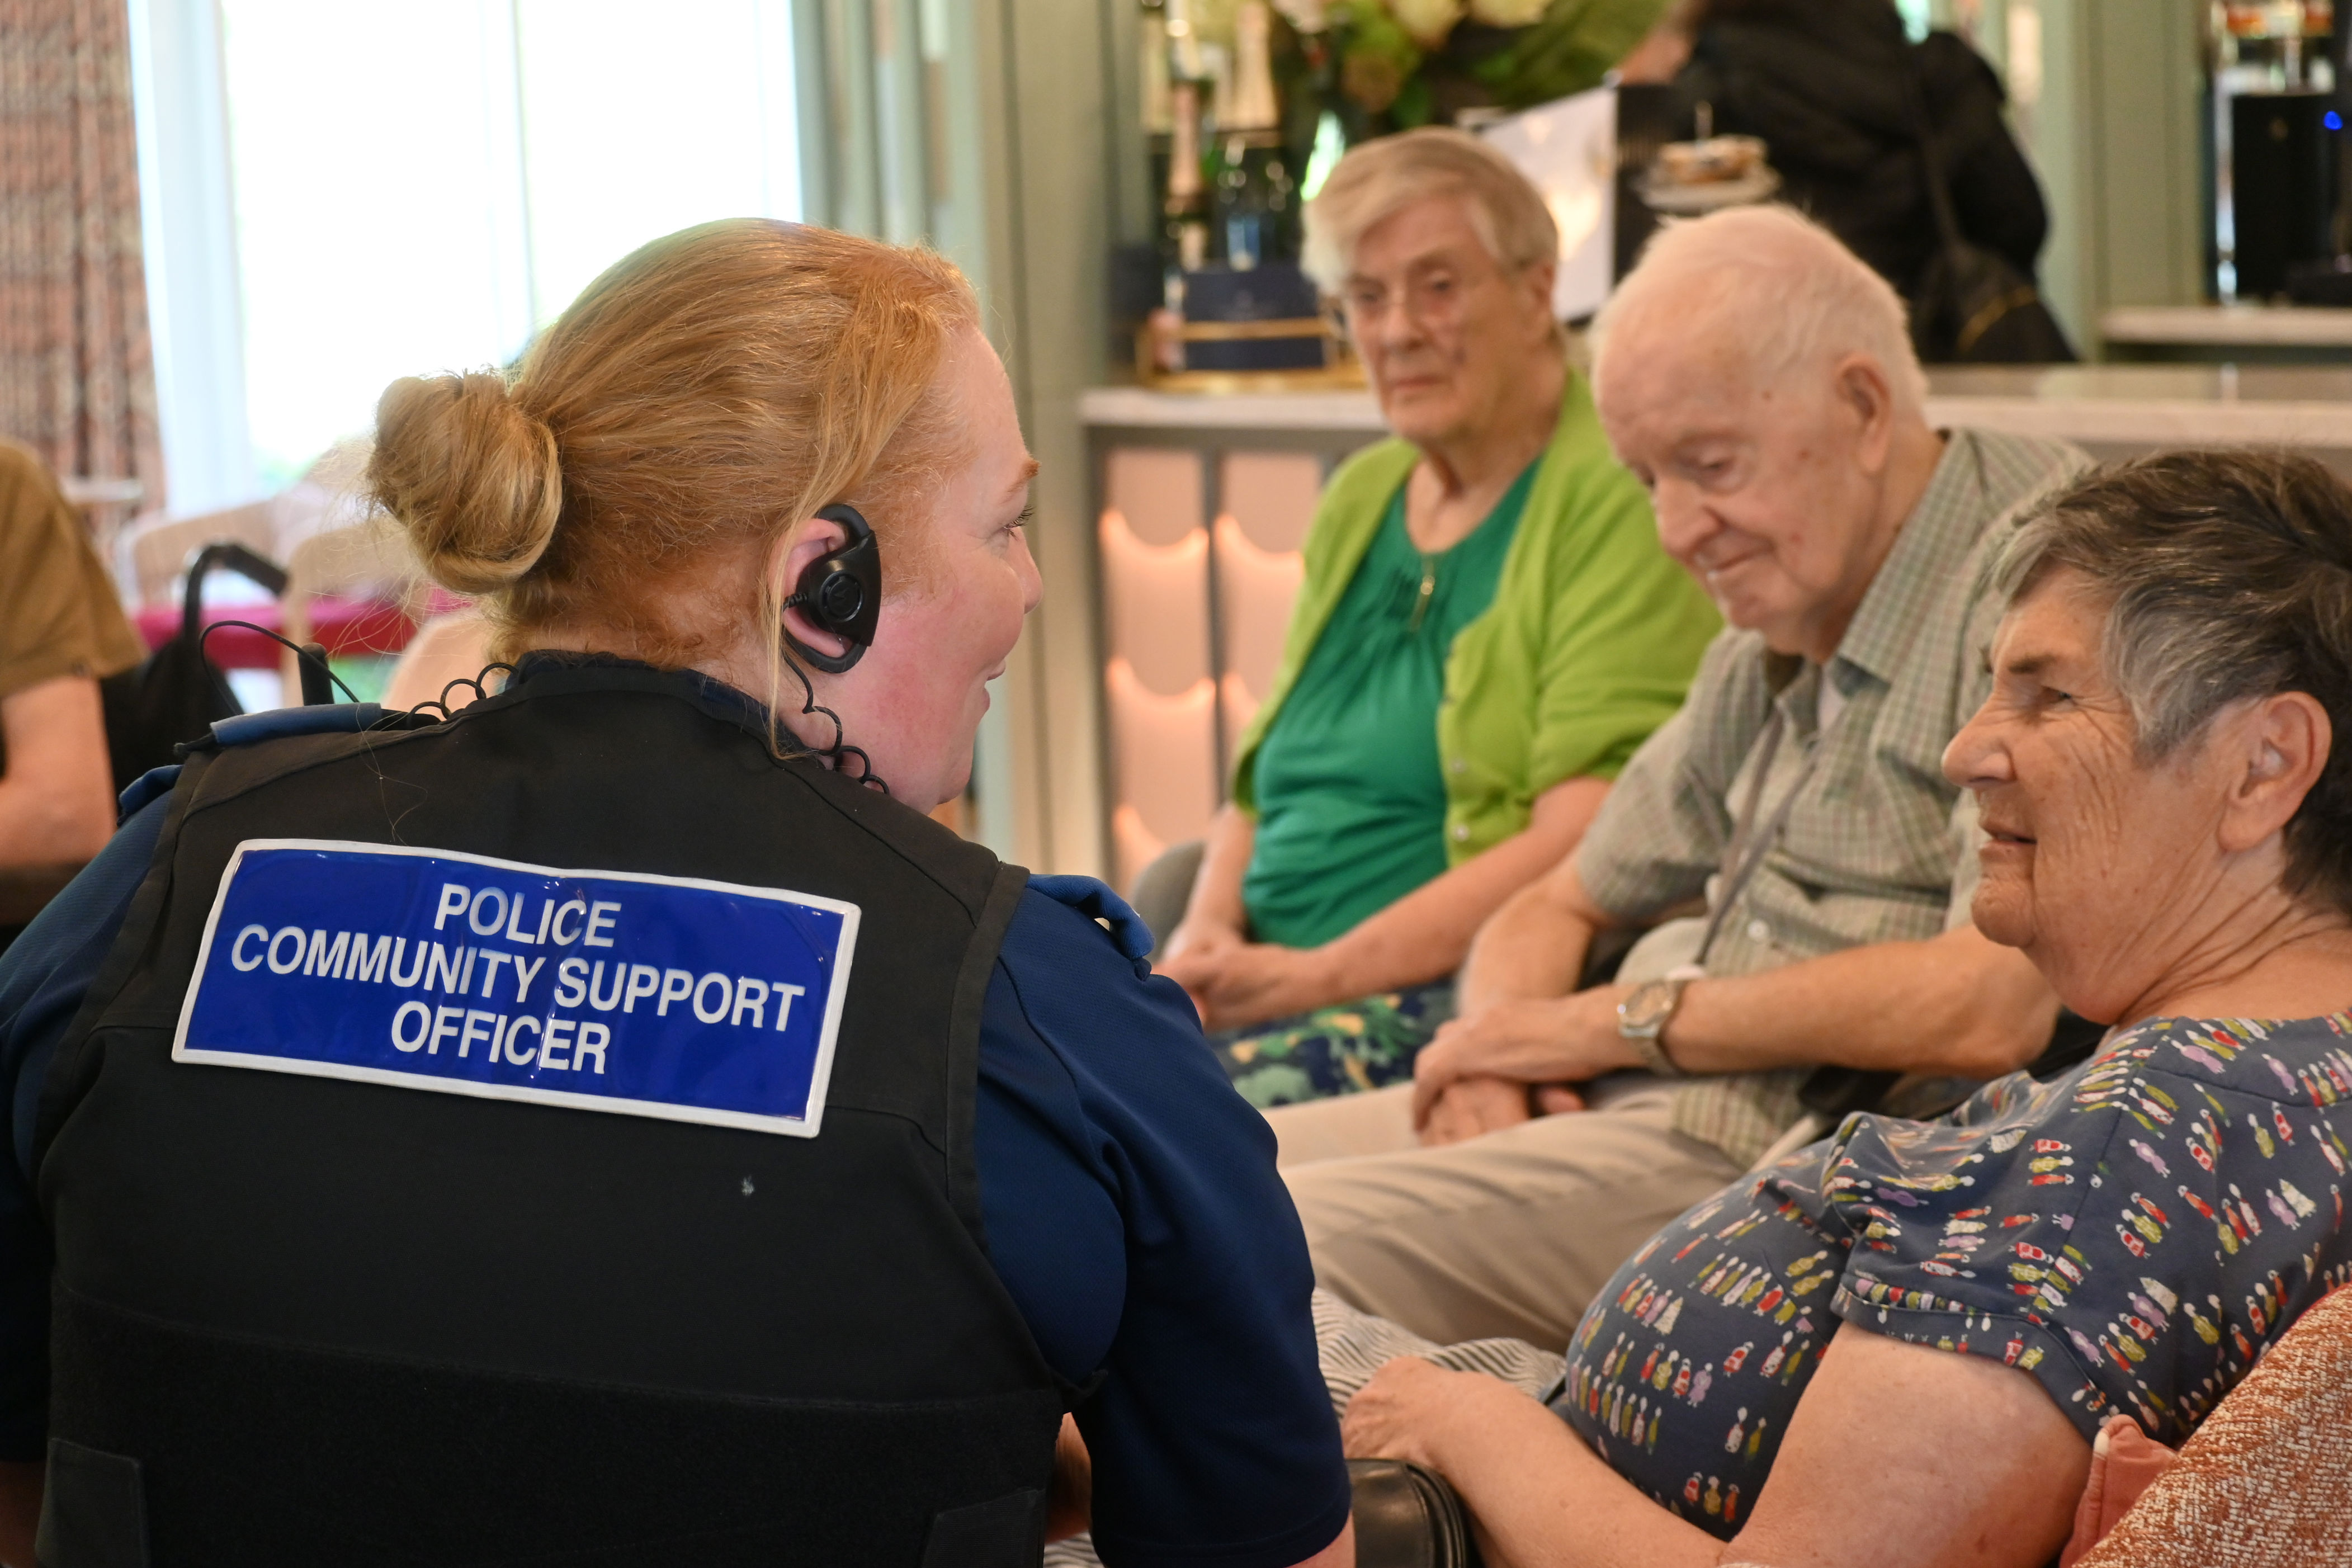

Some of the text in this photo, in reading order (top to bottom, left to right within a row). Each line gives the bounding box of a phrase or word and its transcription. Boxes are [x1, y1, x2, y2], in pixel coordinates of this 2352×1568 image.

[434, 882, 621, 947] POLICE
[231, 924, 805, 1031] COMMUNITY SUPPORT
[391, 1000, 611, 1074] OFFICER
